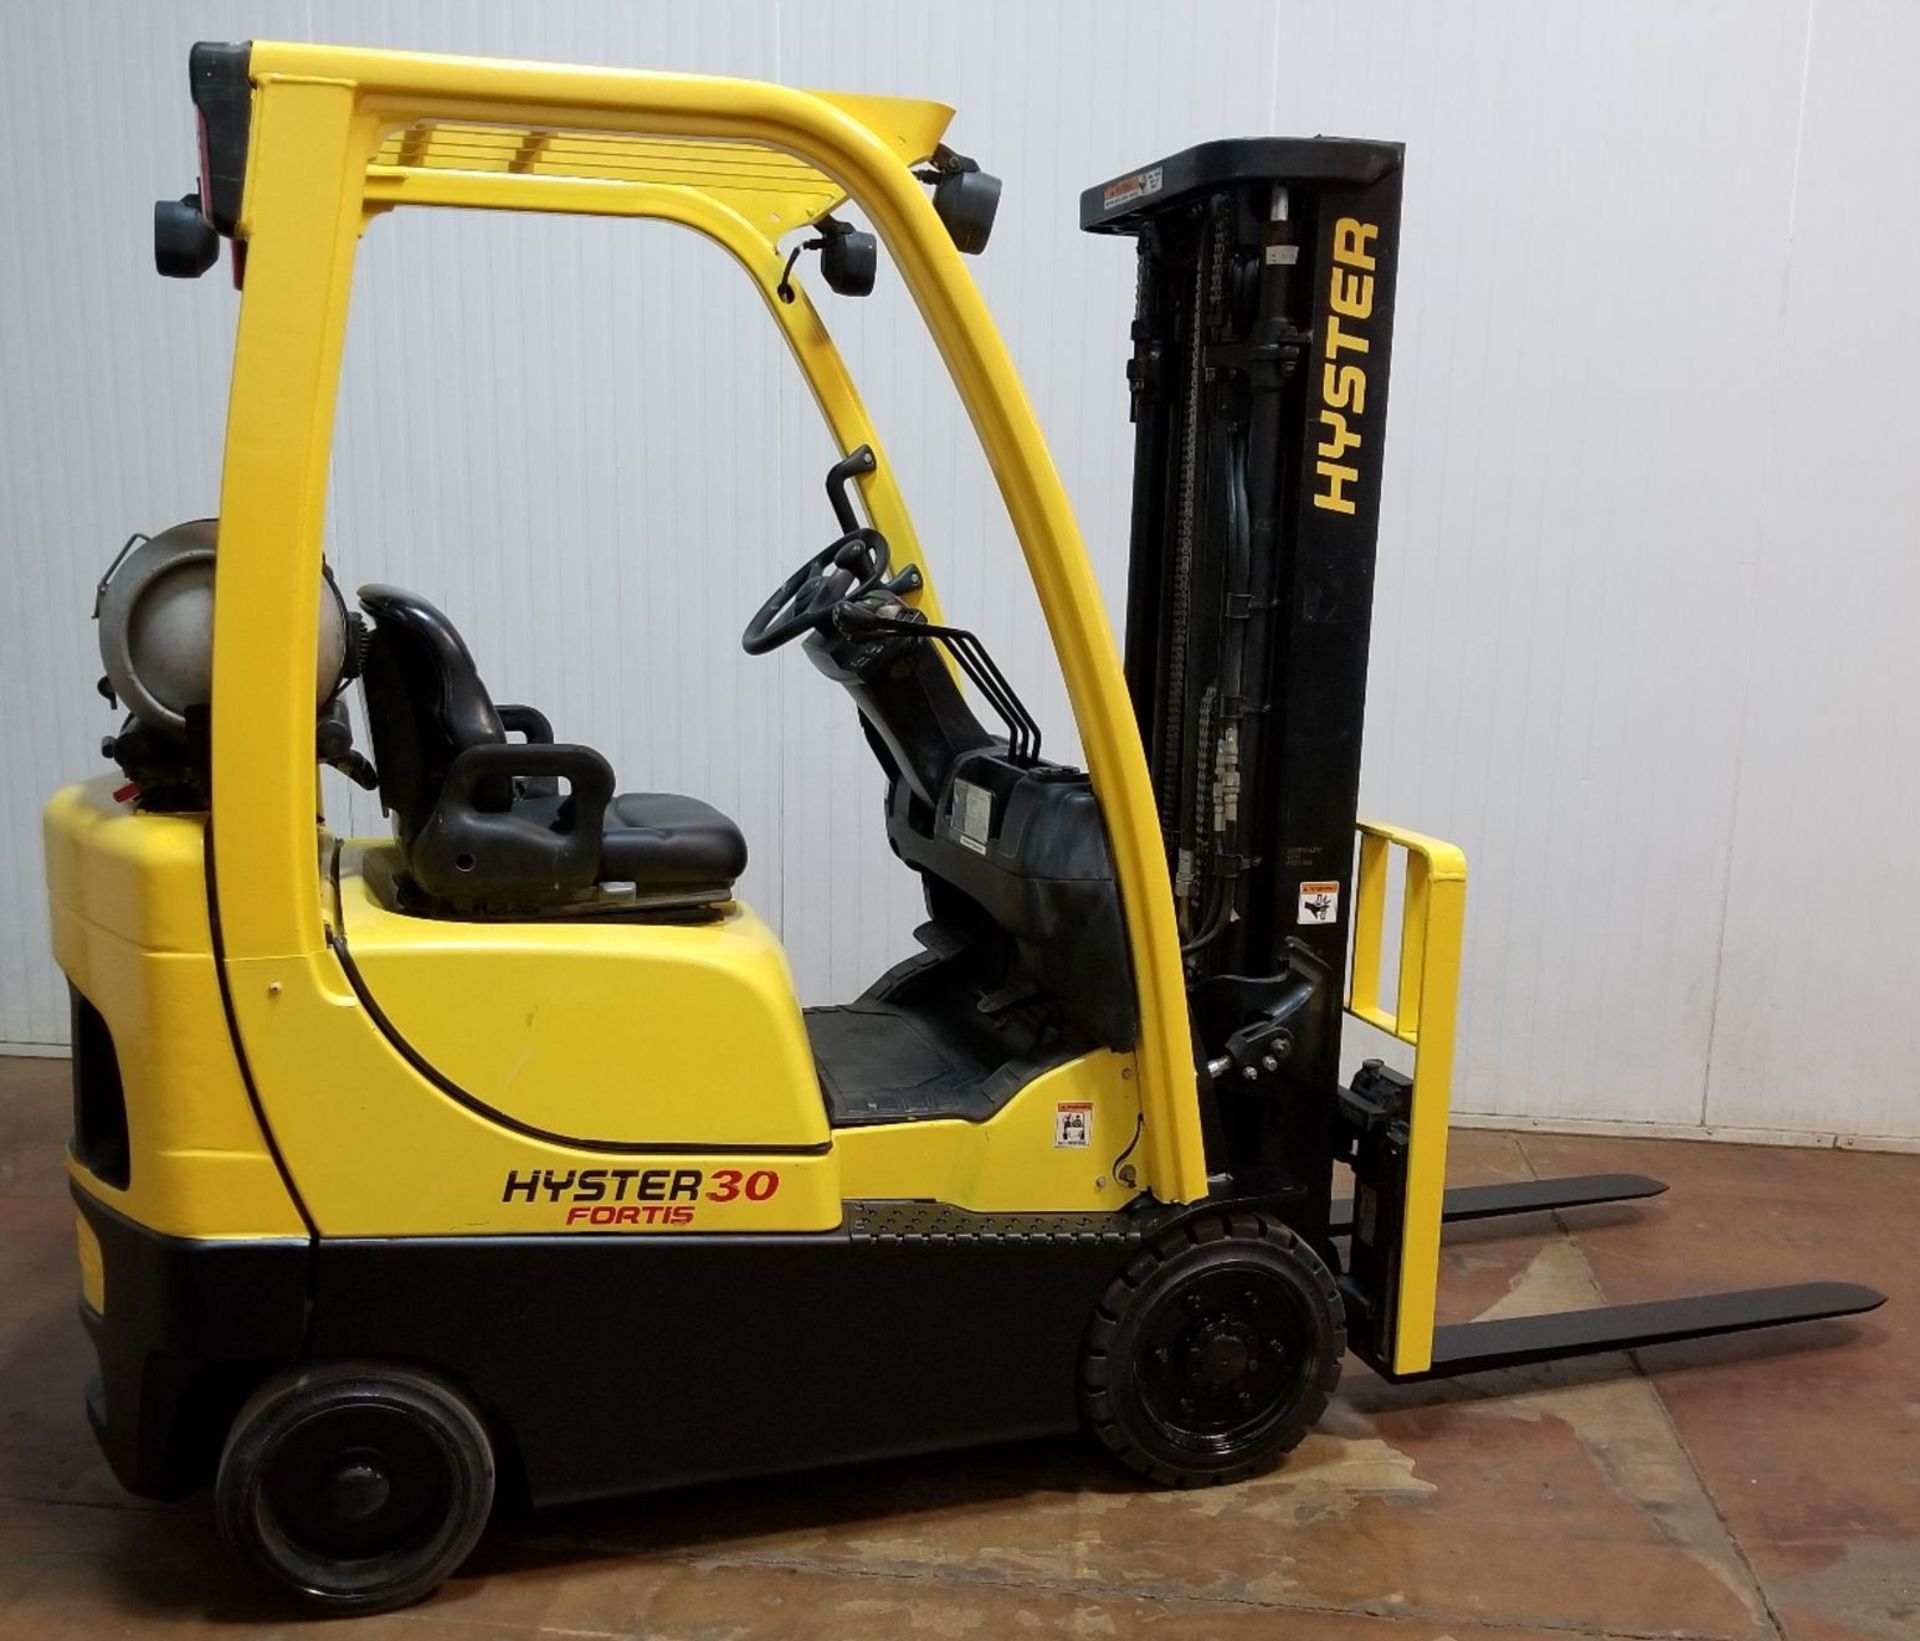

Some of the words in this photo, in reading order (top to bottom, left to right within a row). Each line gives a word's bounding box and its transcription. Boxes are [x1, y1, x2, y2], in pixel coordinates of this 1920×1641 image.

[1314, 217, 1378, 514] HYSTER
[503, 1170, 703, 1202] HYSTER
[705, 1170, 780, 1202] 30
[566, 1206, 695, 1226] FORTIS
